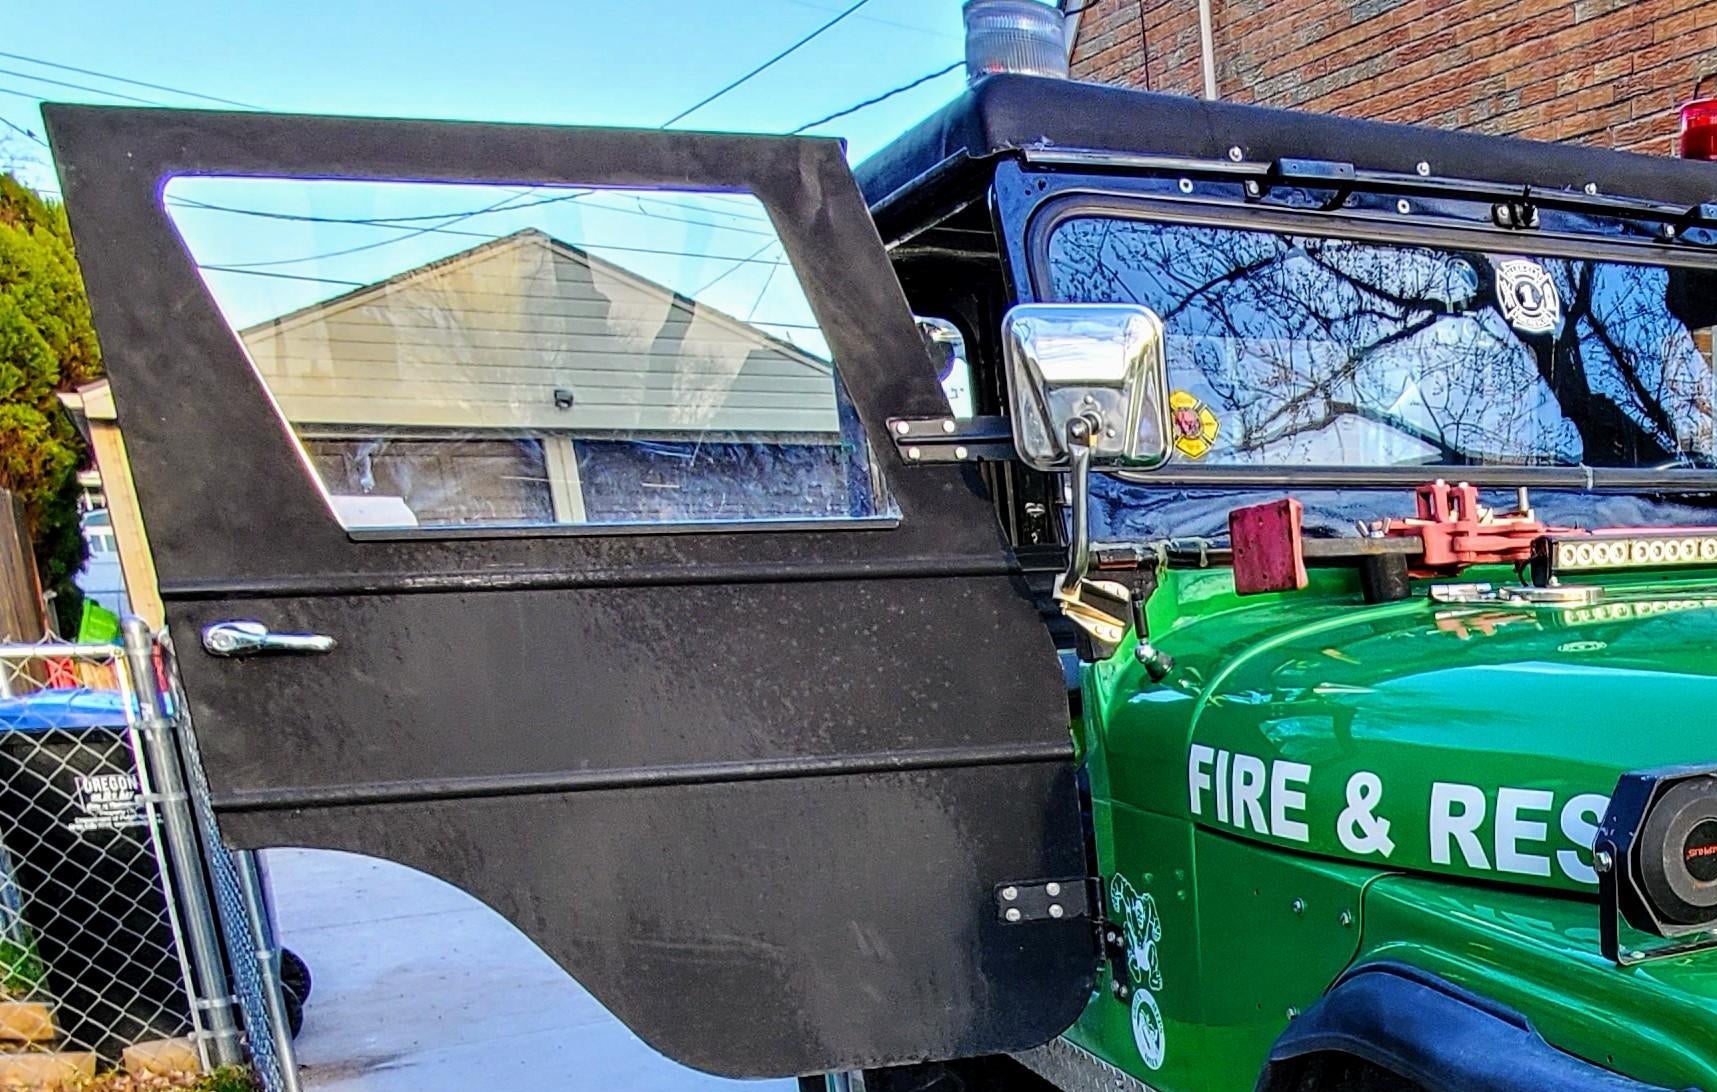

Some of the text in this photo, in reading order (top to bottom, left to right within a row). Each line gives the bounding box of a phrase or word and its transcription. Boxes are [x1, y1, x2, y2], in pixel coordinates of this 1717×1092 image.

[82, 774, 138, 793] OREGON
[1188, 743, 1312, 843] FIRE
[1336, 771, 1396, 858] &
